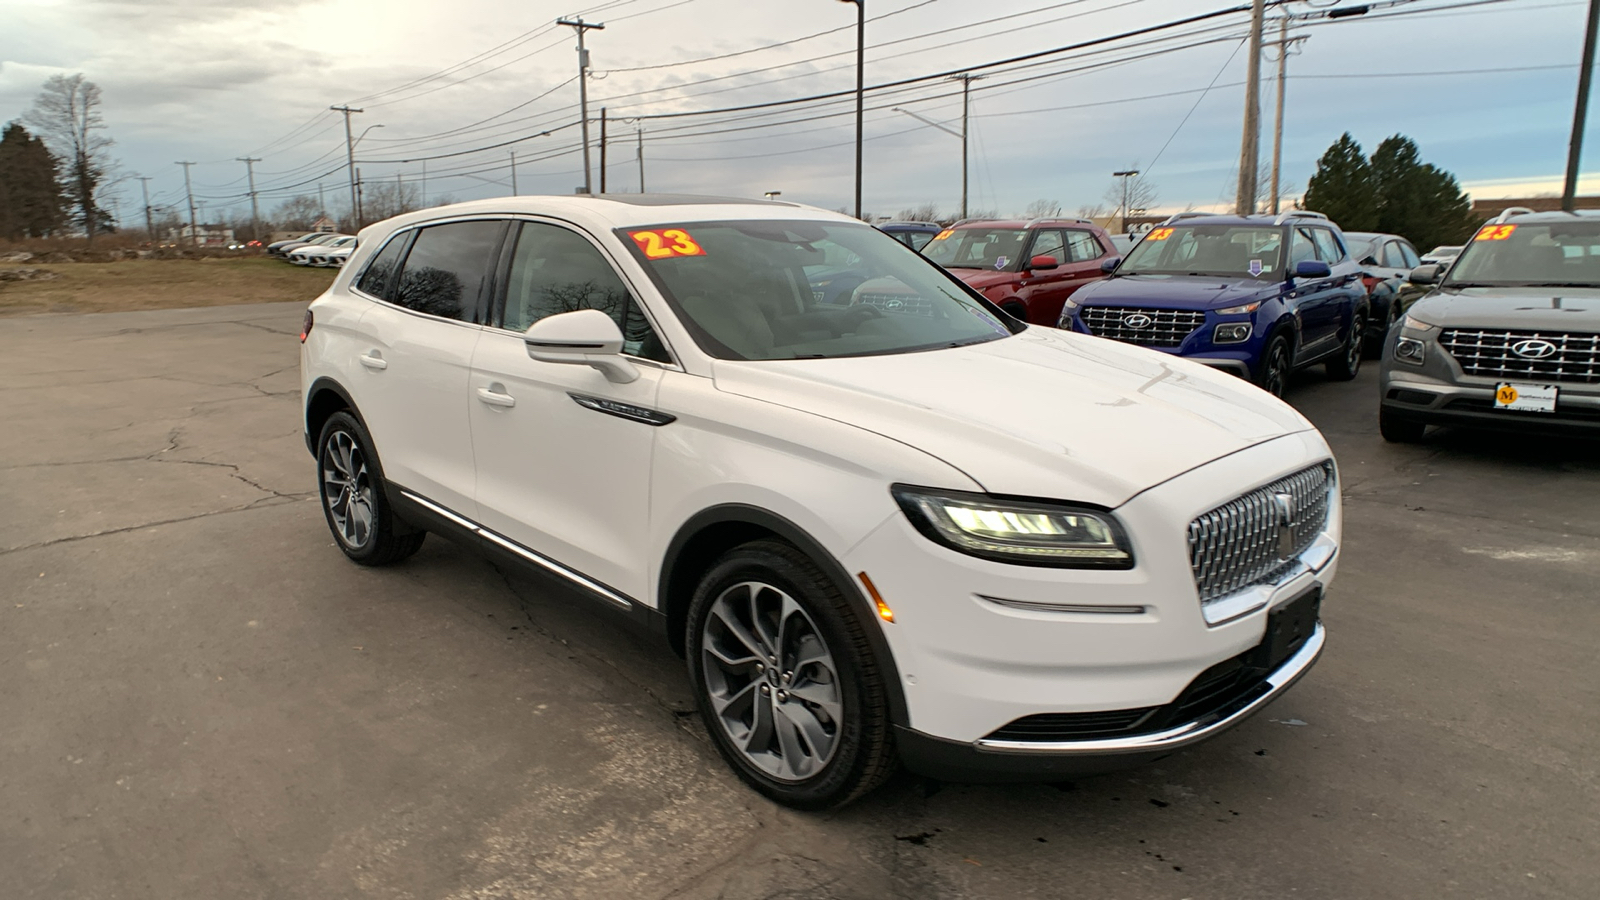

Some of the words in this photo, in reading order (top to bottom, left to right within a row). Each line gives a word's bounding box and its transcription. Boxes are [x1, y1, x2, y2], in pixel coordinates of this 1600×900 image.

[1146, 228, 1174, 240] 23
[1475, 225, 1516, 240] 23
[633, 229, 700, 257] 23
[1500, 391, 1514, 400] M
